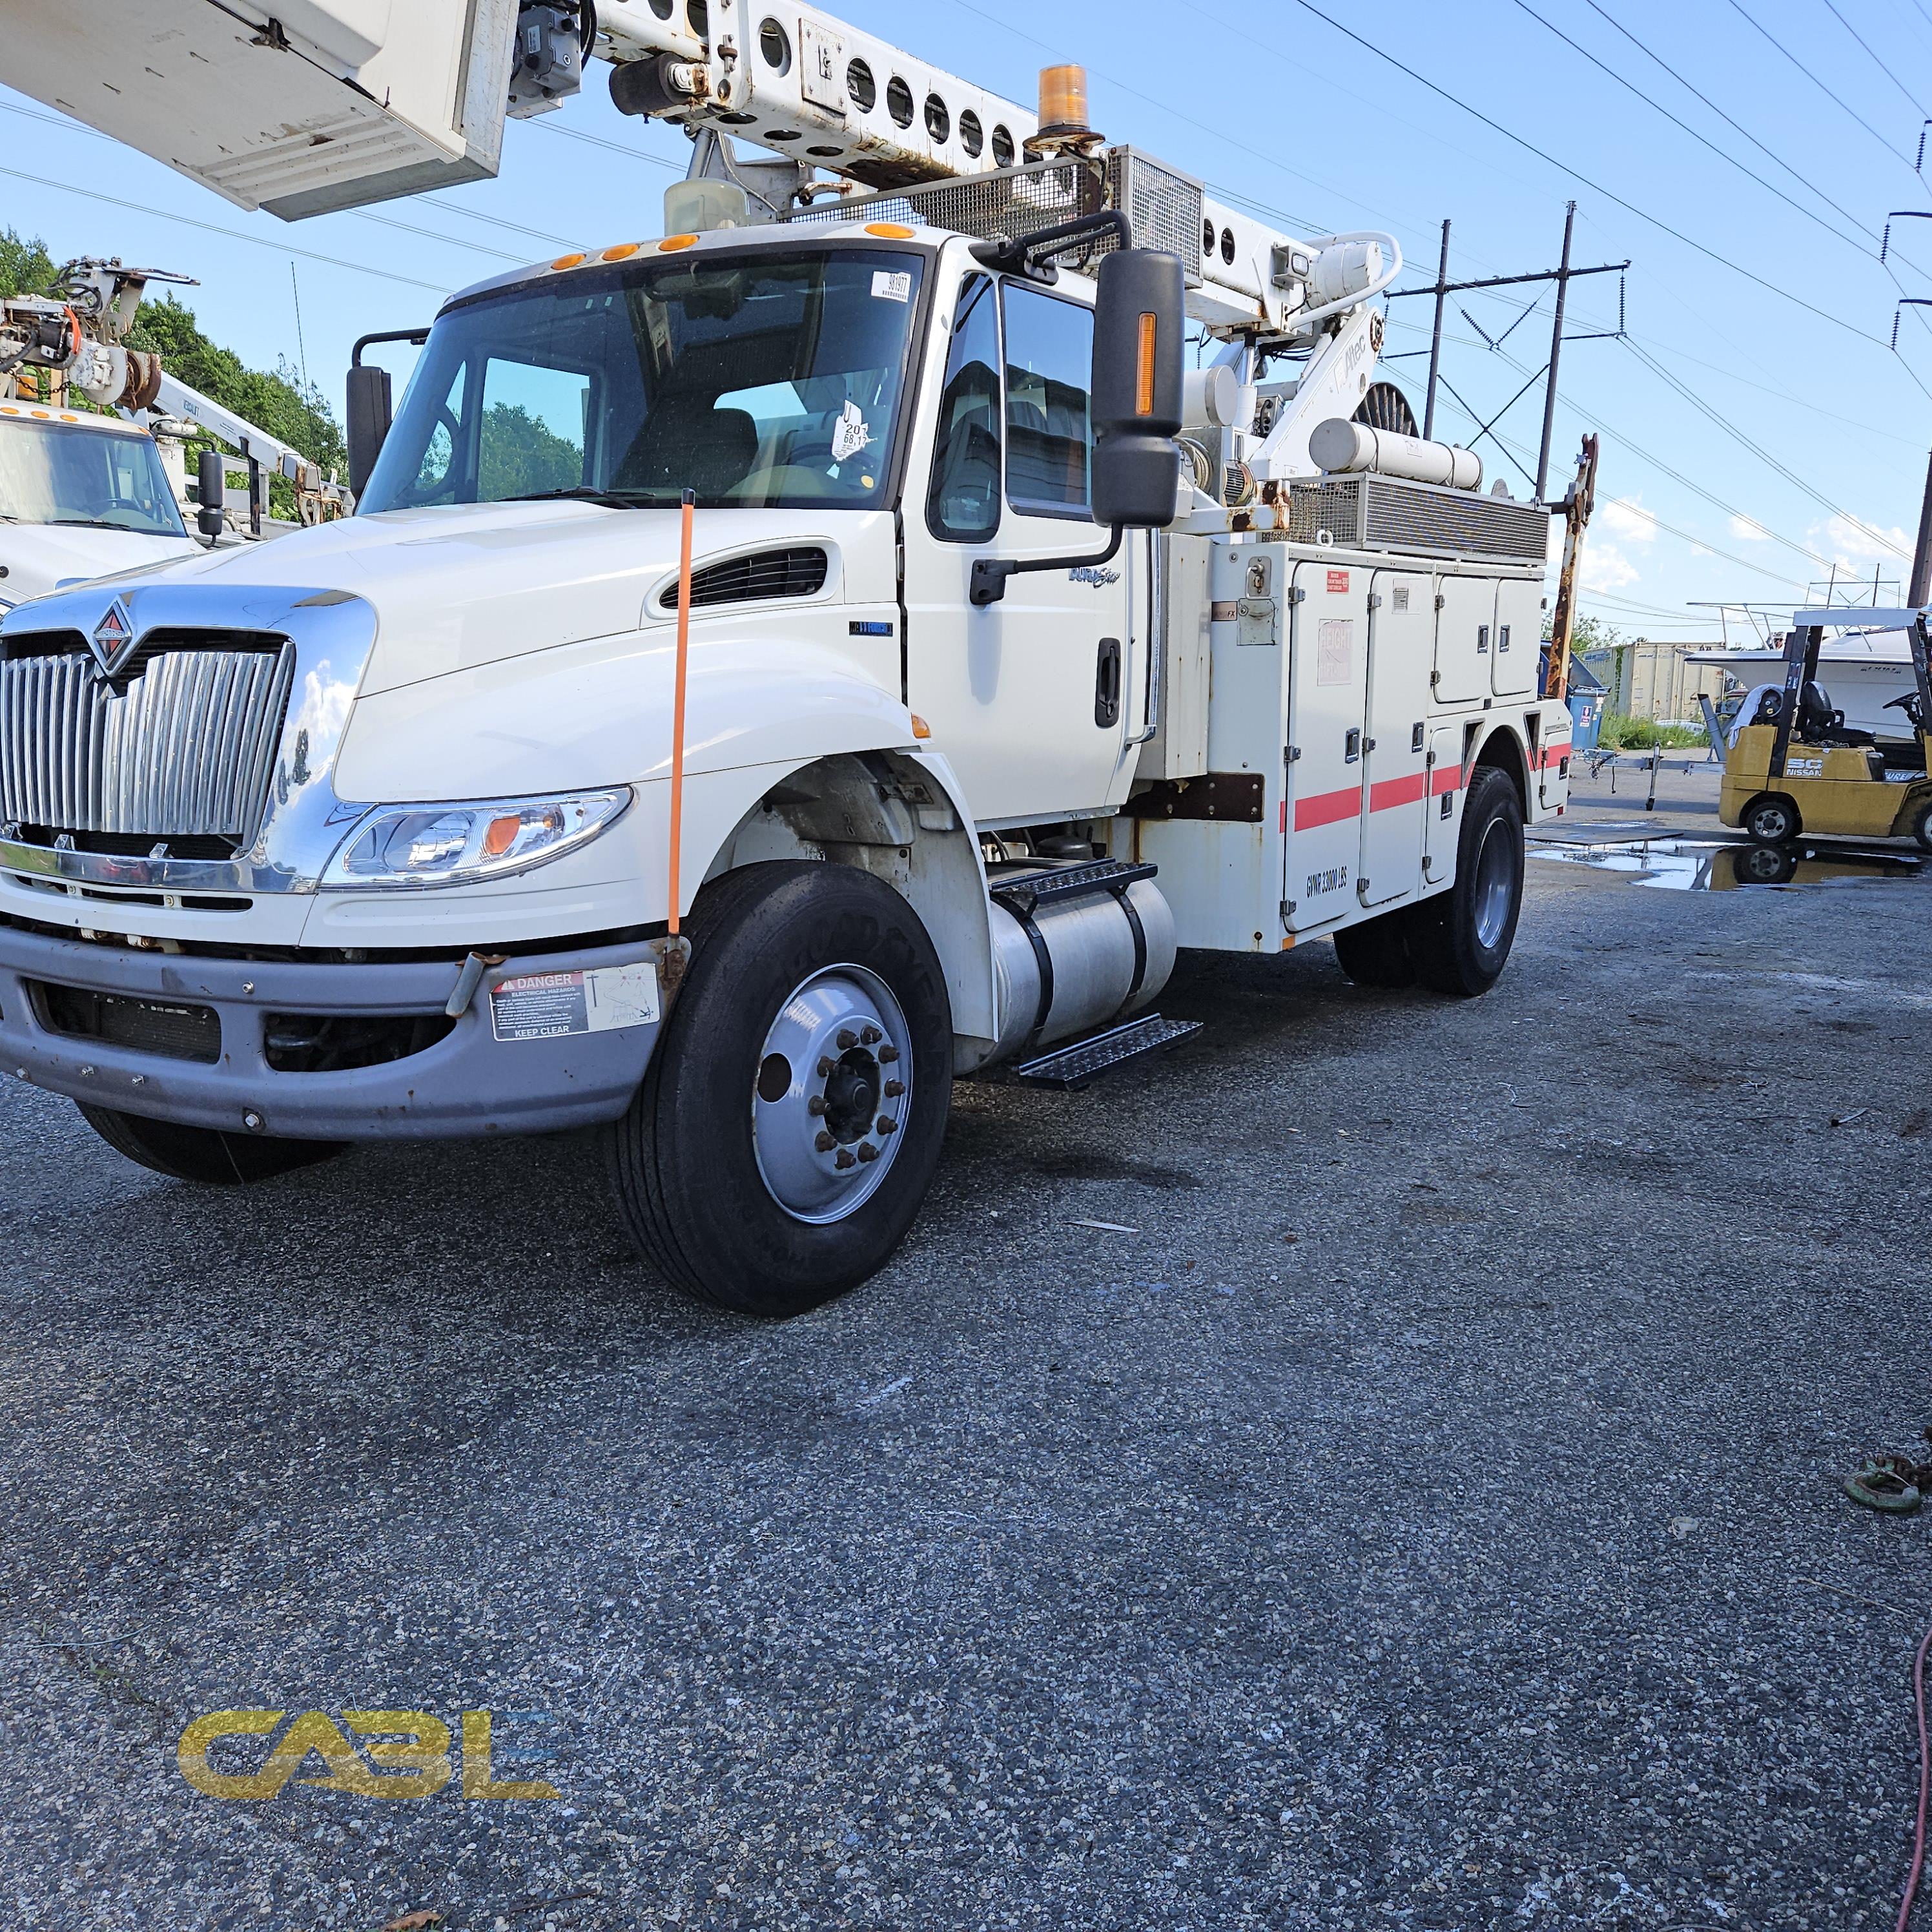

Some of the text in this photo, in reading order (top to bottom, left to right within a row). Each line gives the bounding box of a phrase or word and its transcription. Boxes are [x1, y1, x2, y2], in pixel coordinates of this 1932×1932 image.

[889, 273, 907, 293] 981977
[1344, 334, 1366, 378] Altec
[1787, 768, 1822, 777] NISSAN
[1338, 865, 1347, 889] LBS
[517, 974, 572, 989] DANGER
[511, 986, 576, 998] ELECTRICAL HAZARDS
[515, 1025, 570, 1038] KEEP CLEAR
